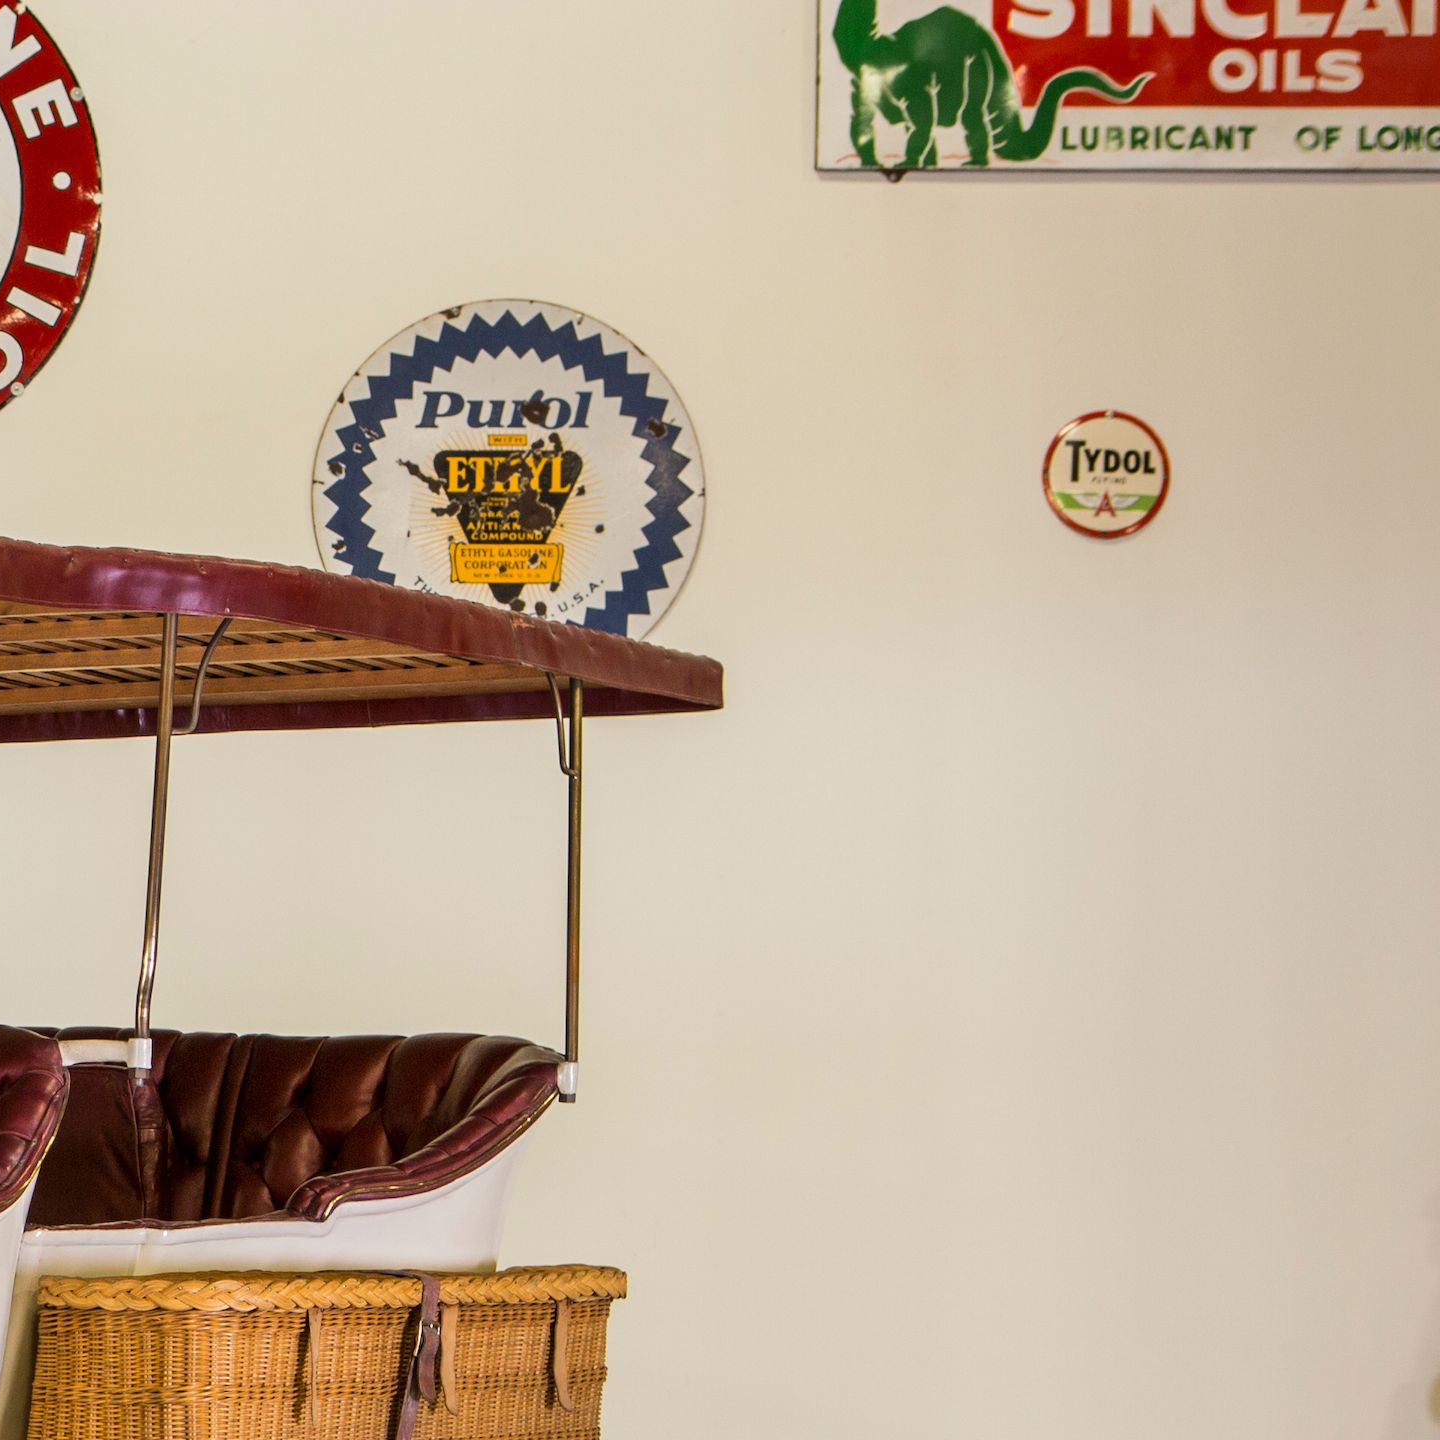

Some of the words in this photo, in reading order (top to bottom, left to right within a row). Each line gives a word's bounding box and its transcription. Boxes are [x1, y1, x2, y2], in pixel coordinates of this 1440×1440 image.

[1208, 48, 1364, 93] OILS
[1061, 125, 1257, 151] LUBRICANT
[1296, 125, 1342, 151] OF
[415, 390, 594, 430] Purol
[1065, 440, 1156, 482] TYDOL
[471, 531, 544, 541] COMPOUND
[460, 548, 495, 557] ETHYL
[464, 560, 548, 570] CORPORATN
